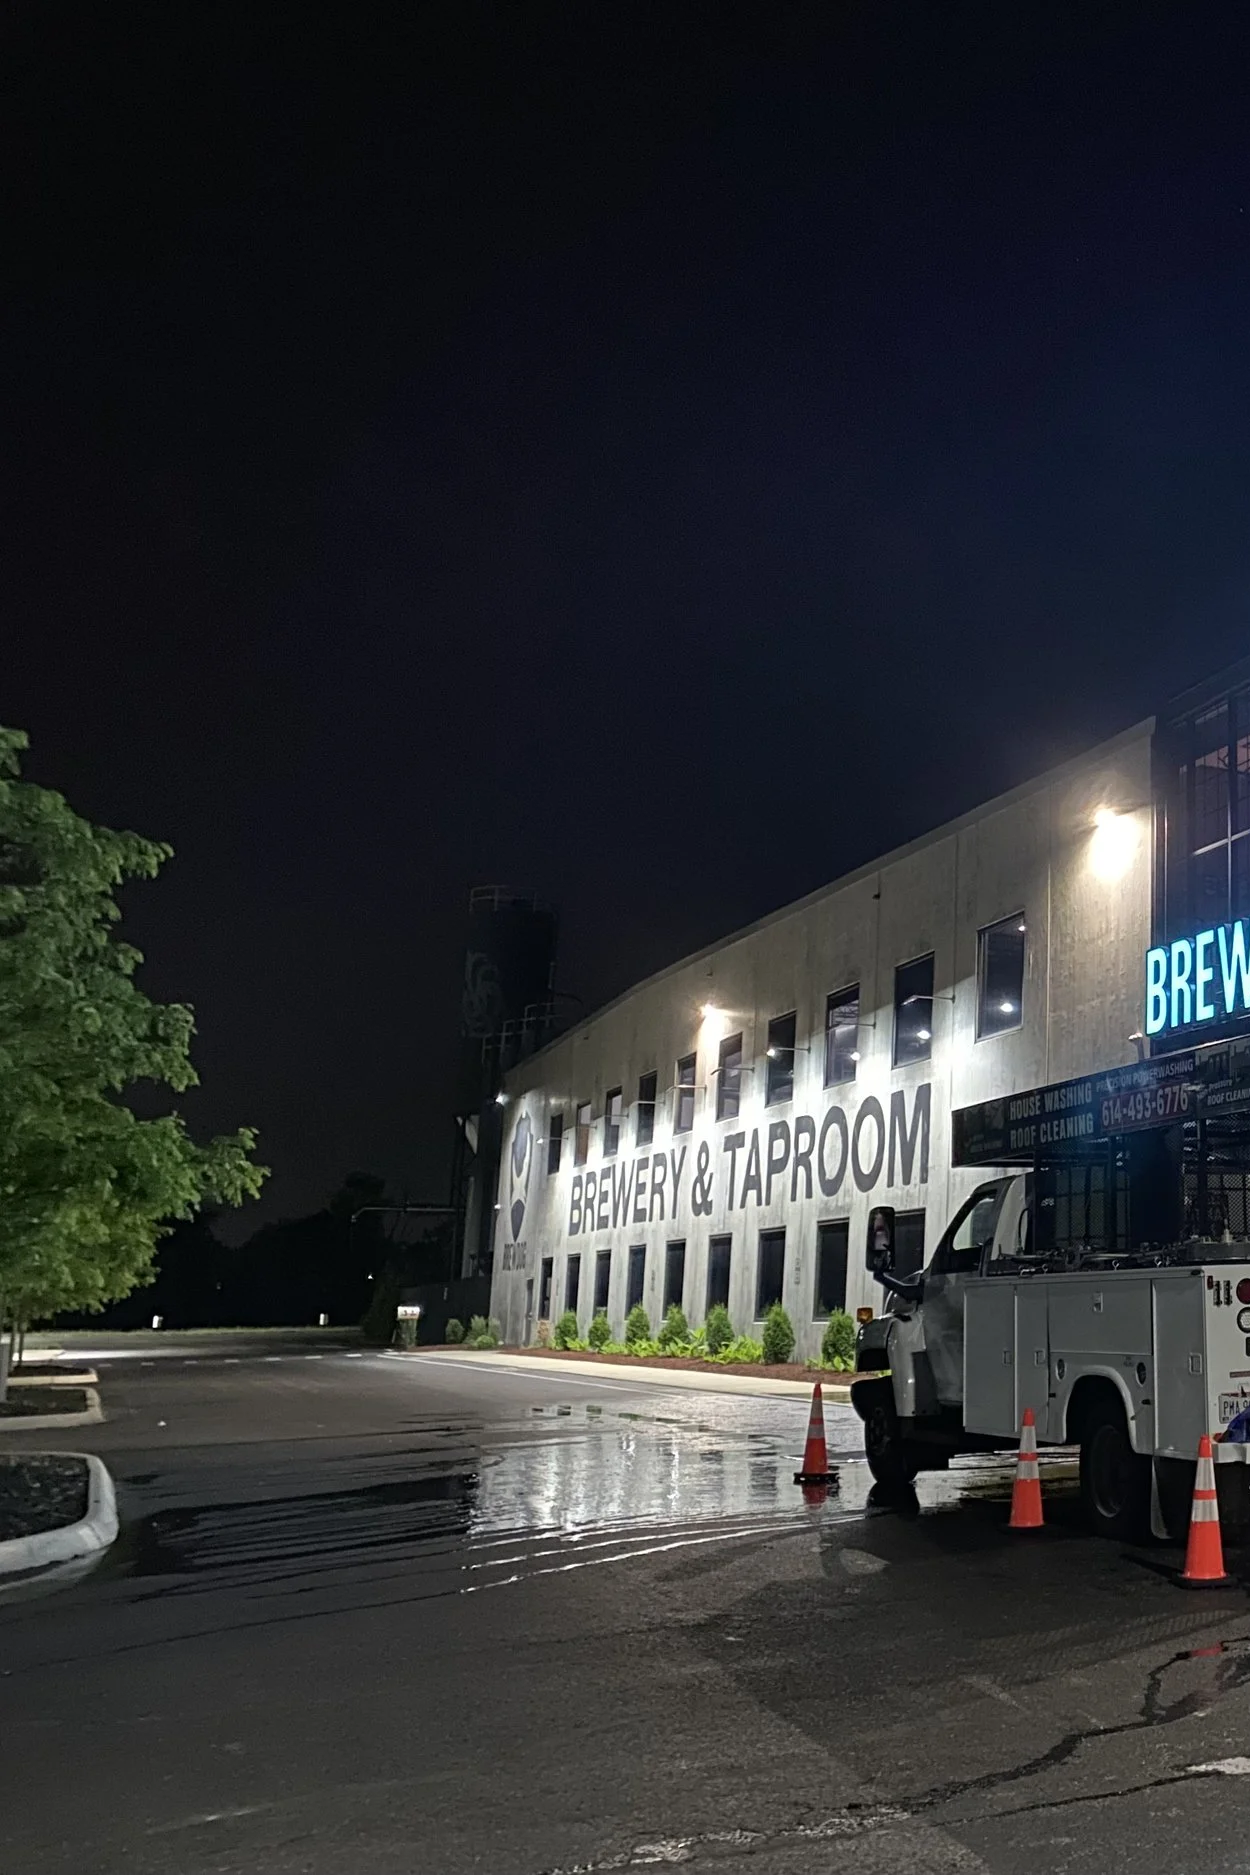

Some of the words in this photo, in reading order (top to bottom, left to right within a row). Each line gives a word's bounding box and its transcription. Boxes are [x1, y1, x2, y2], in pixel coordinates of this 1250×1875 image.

[1009, 1095, 1041, 1121] HOUSE
[1043, 1082, 1092, 1113] WASHING
[1101, 1082, 1189, 1127] 614-493-6776
[1207, 1092, 1225, 1106] ROOF
[1010, 1125, 1036, 1150] ROOF
[1040, 1112, 1094, 1144] CLEANING
[569, 1146, 688, 1236] BREWERY
[691, 1141, 714, 1217] &
[724, 1083, 932, 1211] TAPROOM
